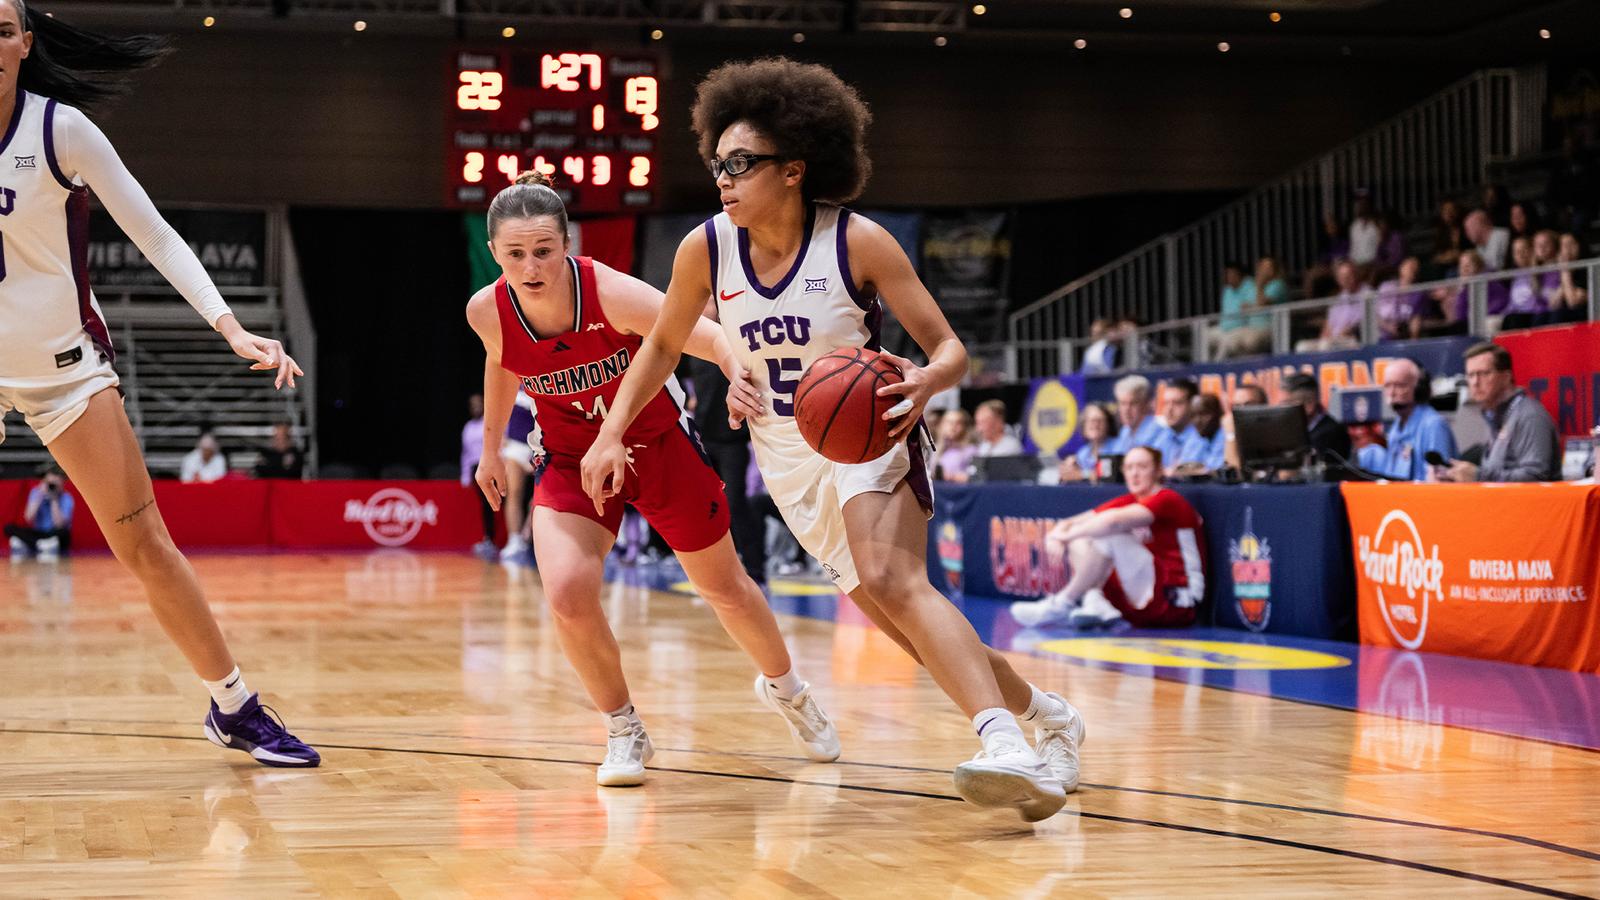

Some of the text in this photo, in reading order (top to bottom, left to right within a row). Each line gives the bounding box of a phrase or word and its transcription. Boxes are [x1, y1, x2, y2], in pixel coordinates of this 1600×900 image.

[458, 71, 502, 110] 22
[592, 104, 604, 131] 1
[463, 152, 484, 183] 2
[592, 155, 611, 185] 3
[629, 156, 650, 186] 2
[740, 315, 811, 352] TCU
[523, 347, 631, 396] RICHMOND
[765, 358, 803, 417] 5
[344, 499, 438, 526] Hard Rock
[1359, 535, 1444, 602] Hard Rock
[1469, 559, 1554, 580] RIVIERA MAYA
[1524, 585, 1587, 603] EXPERIENCE
